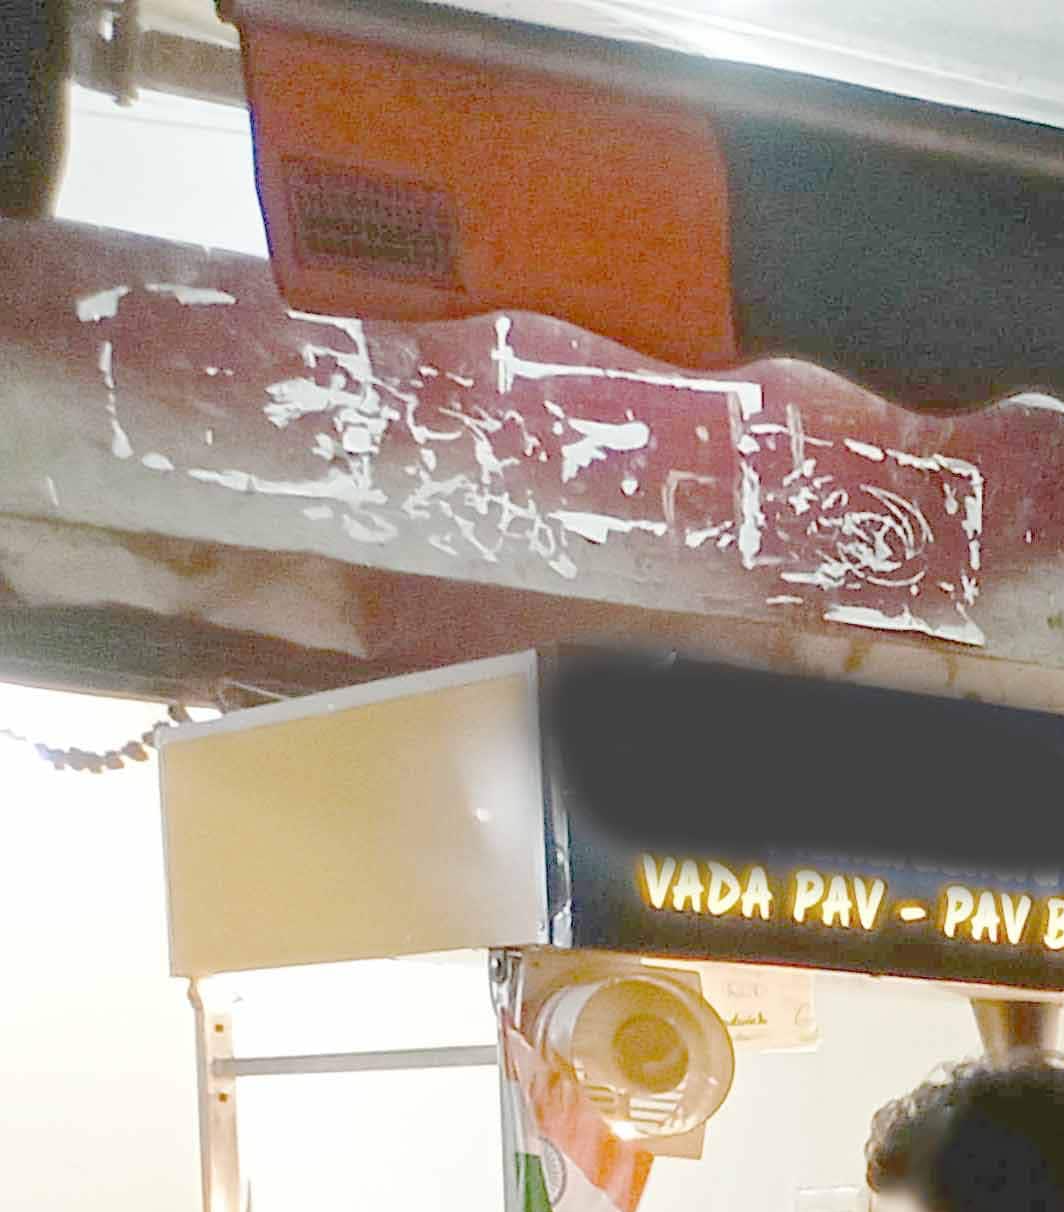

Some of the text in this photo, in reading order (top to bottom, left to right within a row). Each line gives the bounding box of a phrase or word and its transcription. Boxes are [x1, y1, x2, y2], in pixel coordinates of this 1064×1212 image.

[641, 855, 772, 919] VADA
[793, 870, 885, 930] PAV
[943, 885, 1031, 943] PAV
